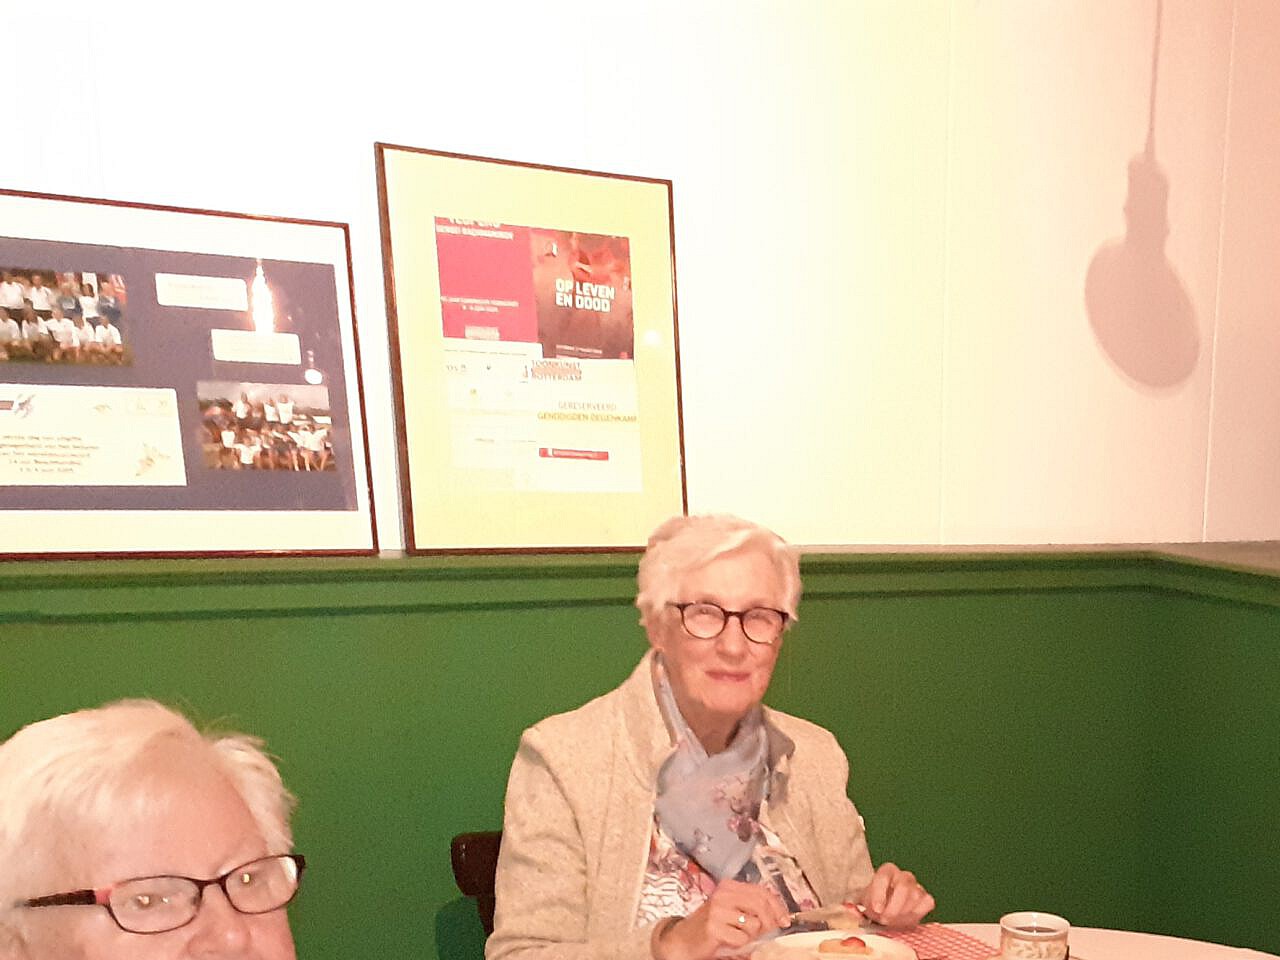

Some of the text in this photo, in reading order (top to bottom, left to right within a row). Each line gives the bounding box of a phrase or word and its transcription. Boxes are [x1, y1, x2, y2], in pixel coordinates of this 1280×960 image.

[555, 278, 615, 300] OP LEVEN
[555, 292, 611, 312] EN DOOD
